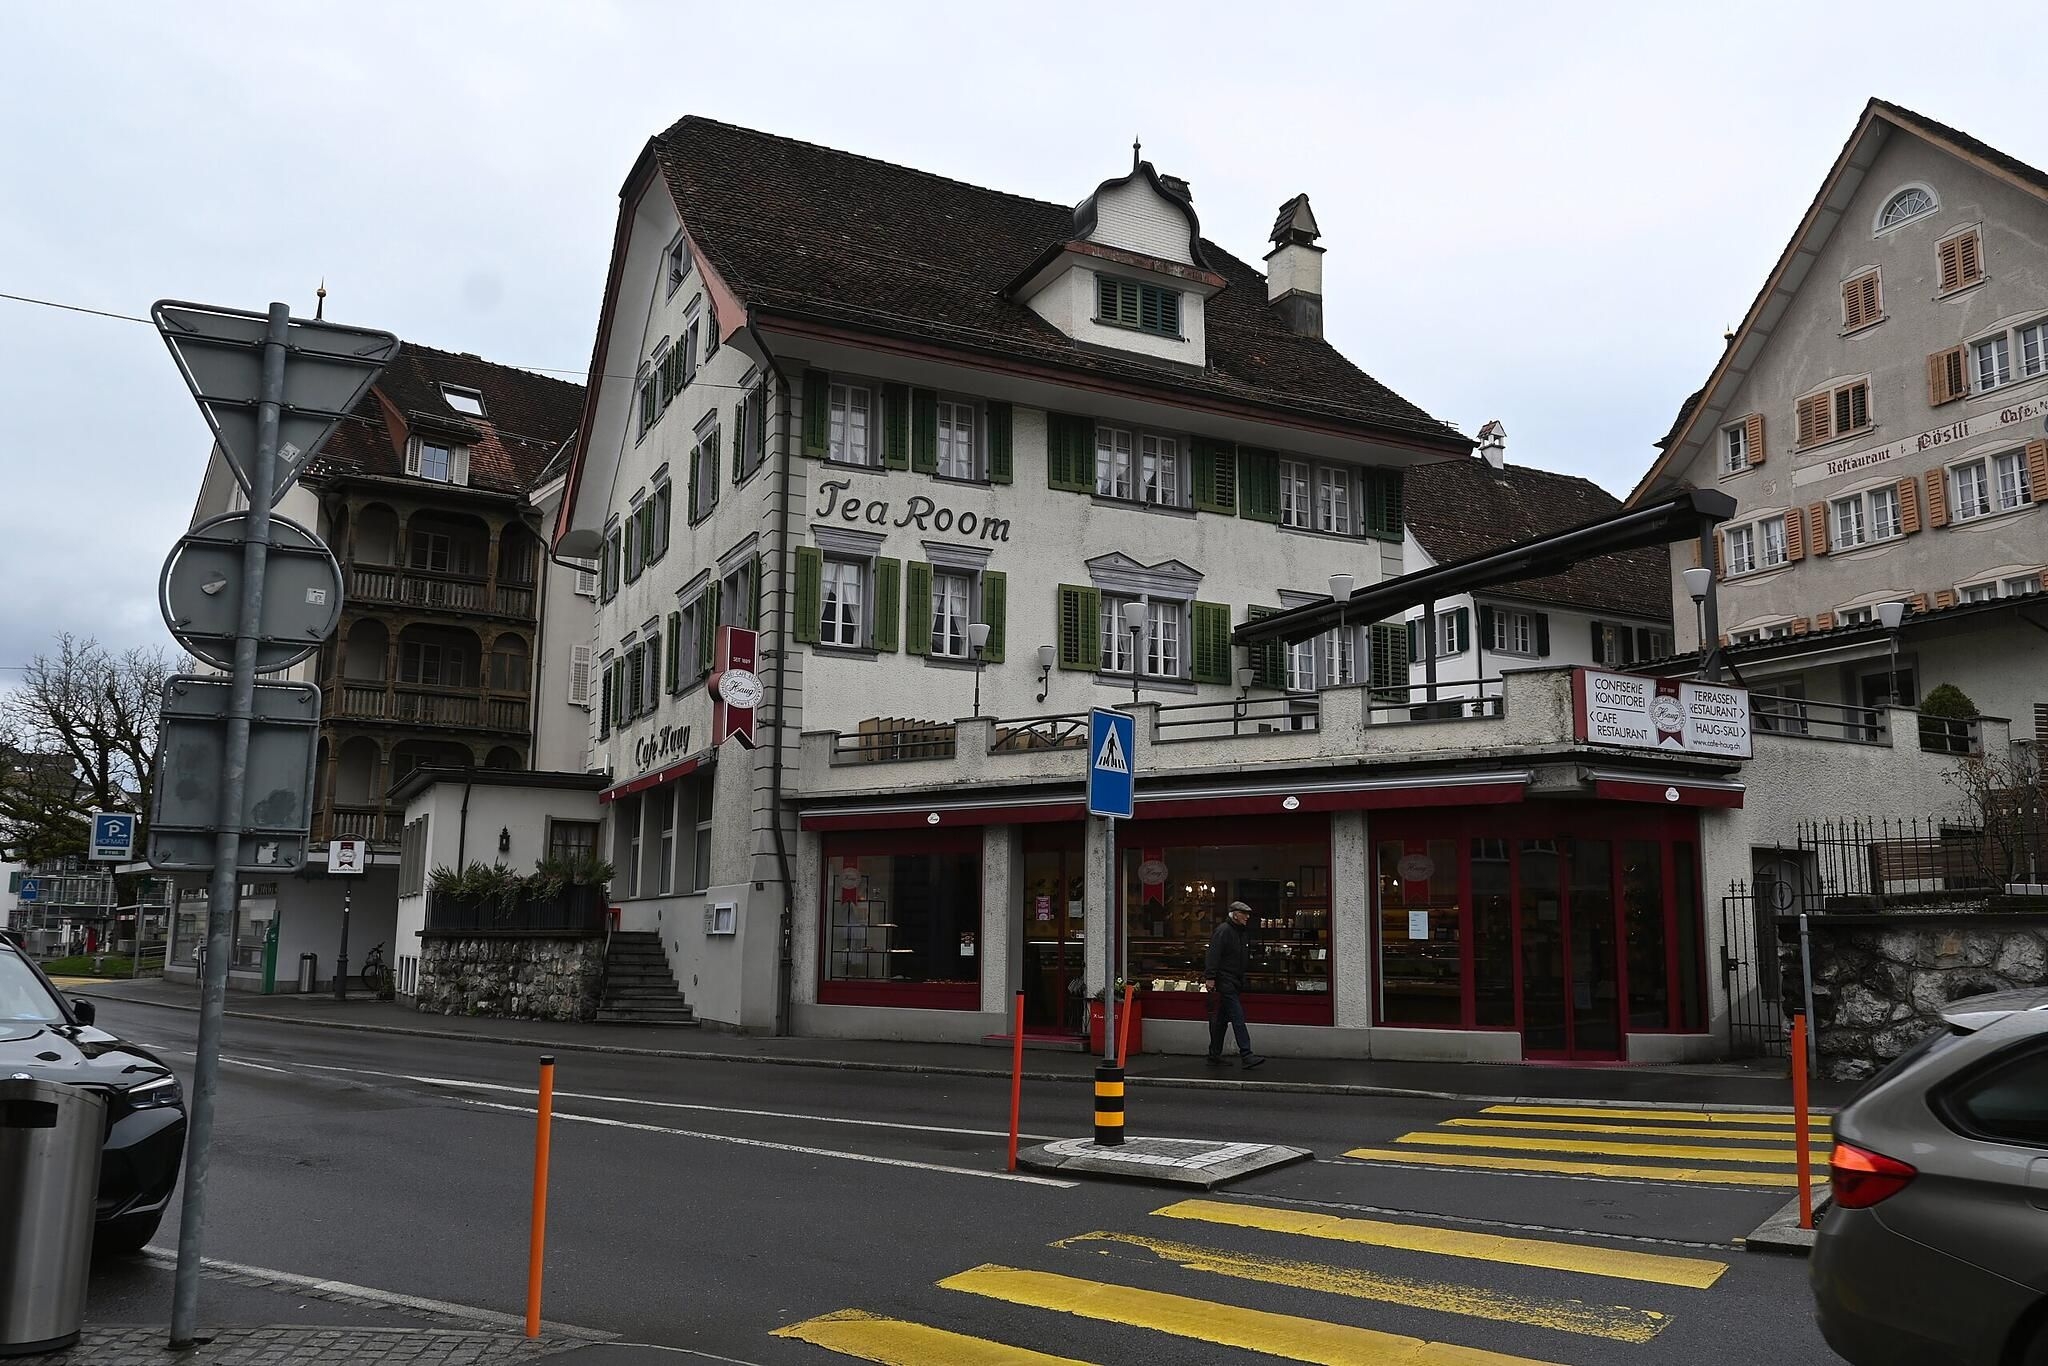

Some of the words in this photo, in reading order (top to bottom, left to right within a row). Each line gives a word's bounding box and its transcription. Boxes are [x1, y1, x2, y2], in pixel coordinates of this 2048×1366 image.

[816, 479, 889, 525] Tea
[894, 495, 1010, 542] Room
[725, 679, 754, 697] Haug
[1595, 678, 1643, 694] CONFISERIE
[1595, 692, 1646, 708] KONDITOREI
[1694, 690, 1737, 705] TERRASSEN
[1654, 706, 1679, 722] Haug
[1689, 703, 1737, 717] RESTAURANT
[1597, 712, 1617, 724] CAFE
[1598, 725, 1647, 740] RESTAURANT
[109, 824, 120, 837] P
